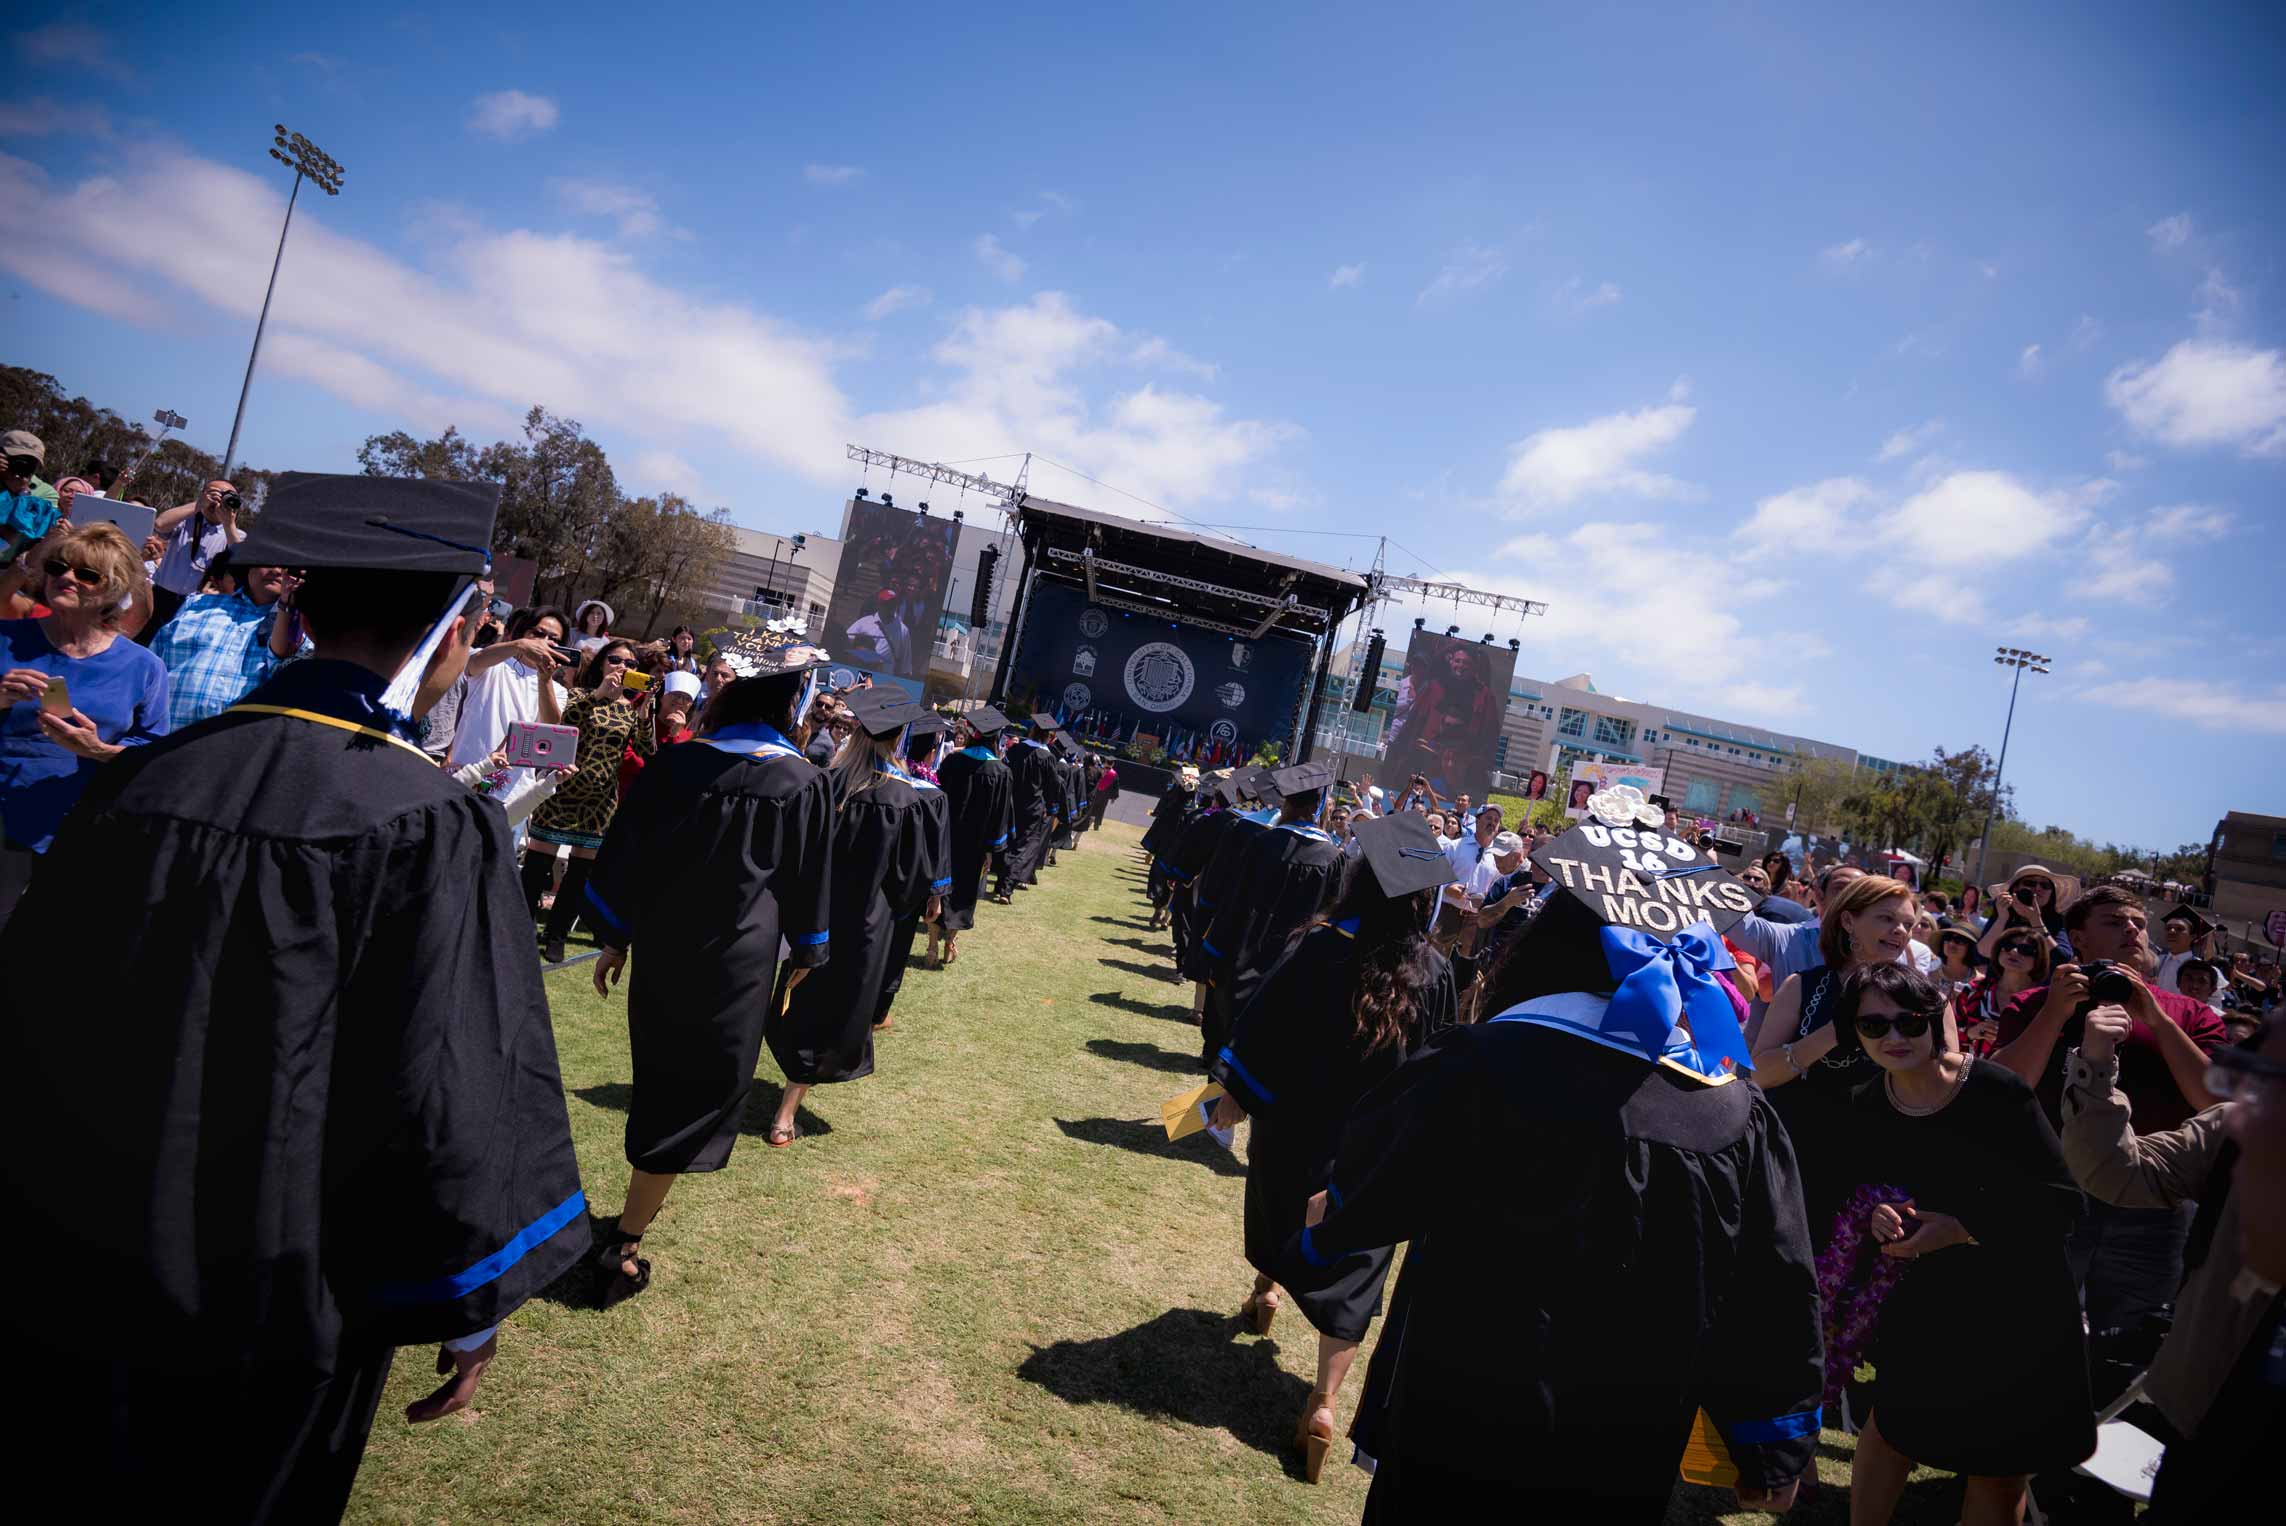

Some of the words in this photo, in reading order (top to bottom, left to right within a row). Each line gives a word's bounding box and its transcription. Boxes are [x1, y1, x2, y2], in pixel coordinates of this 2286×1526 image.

[733, 631, 785, 648] THANK
[737, 640, 768, 652] YOU
[761, 631, 803, 645] KANT
[1579, 825, 1697, 861] UCSD
[1620, 849, 1667, 875] 16
[1549, 857, 1753, 912] THANKS
[1601, 894, 1716, 933] MOM
